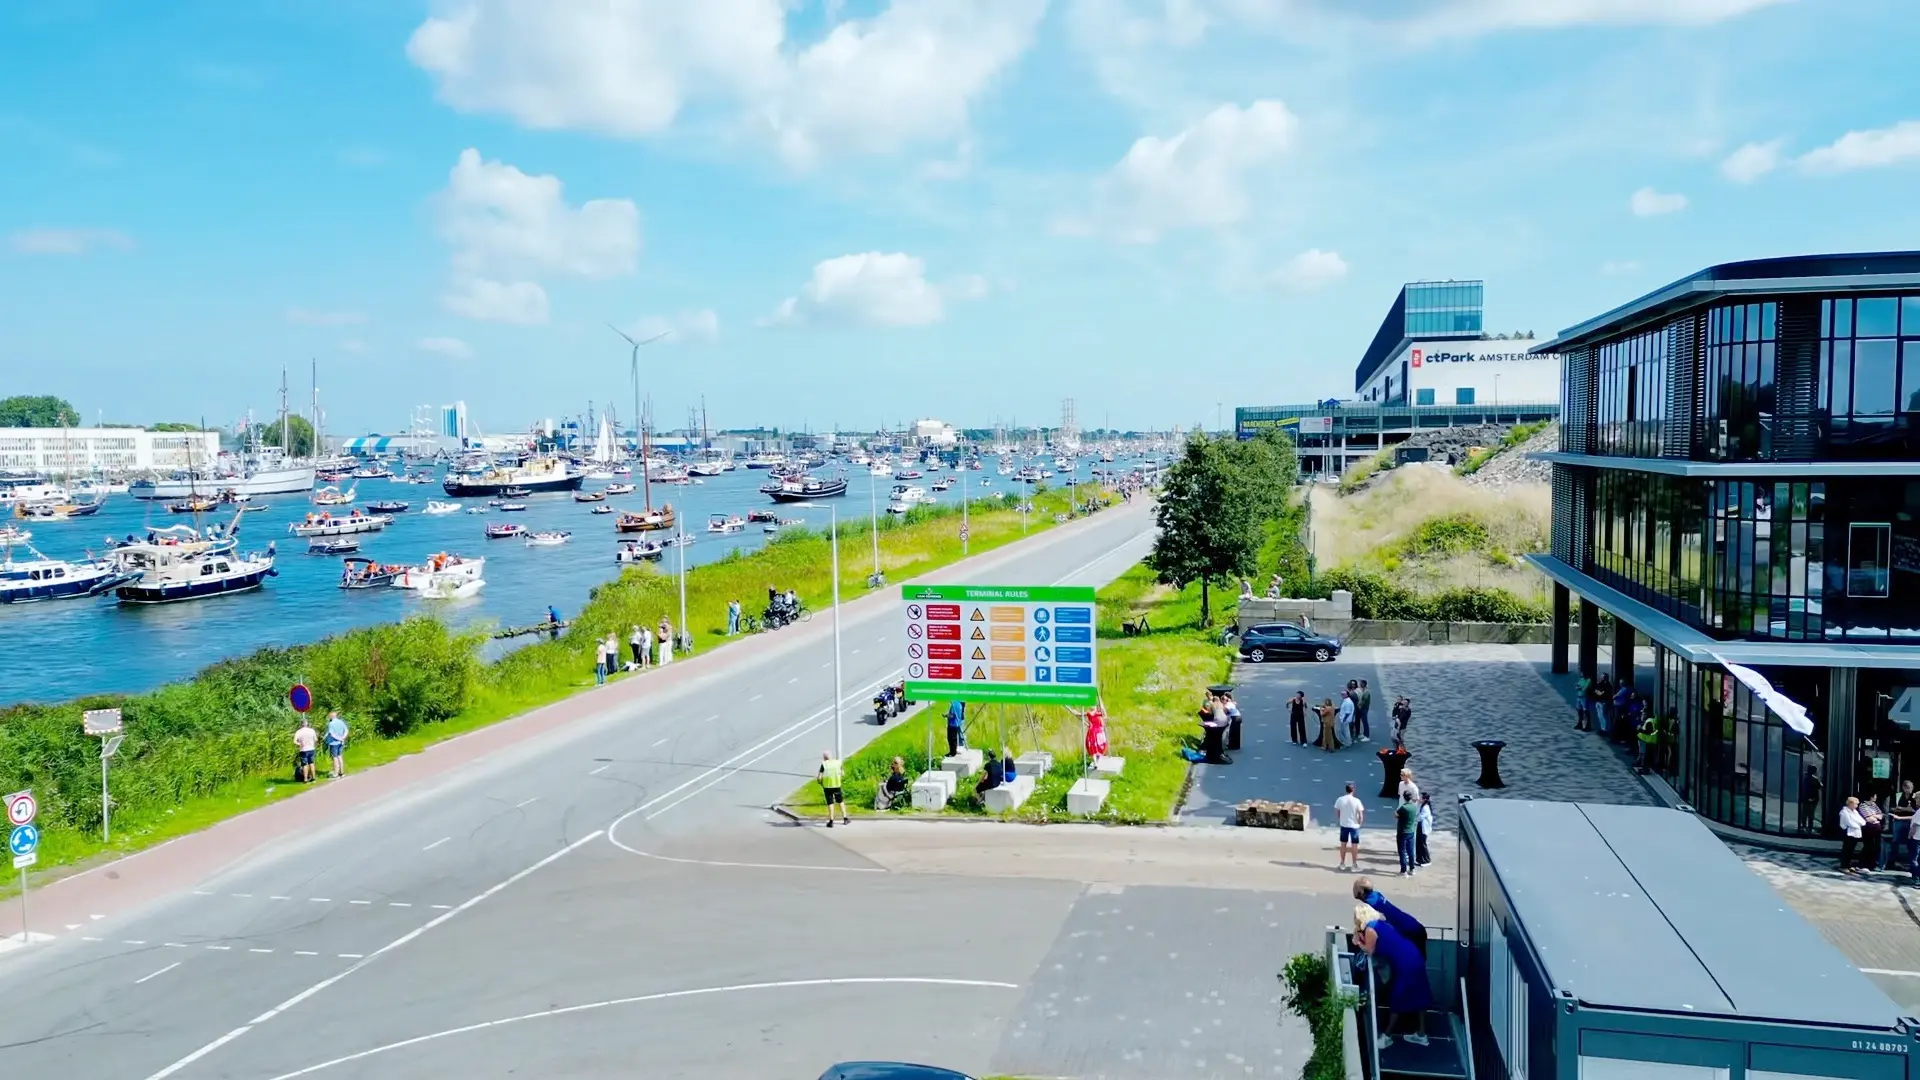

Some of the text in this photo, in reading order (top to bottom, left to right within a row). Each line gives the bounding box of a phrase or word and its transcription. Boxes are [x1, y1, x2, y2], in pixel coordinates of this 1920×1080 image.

[1426, 352, 1475, 363] ctPark
[1479, 353, 1549, 361] AMSTERDAM
[965, 589, 1003, 598] TERMINAL
[1038, 668, 1047, 680] P
[1888, 687, 1920, 730] 4
[1852, 1040, 1862, 1049] 01
